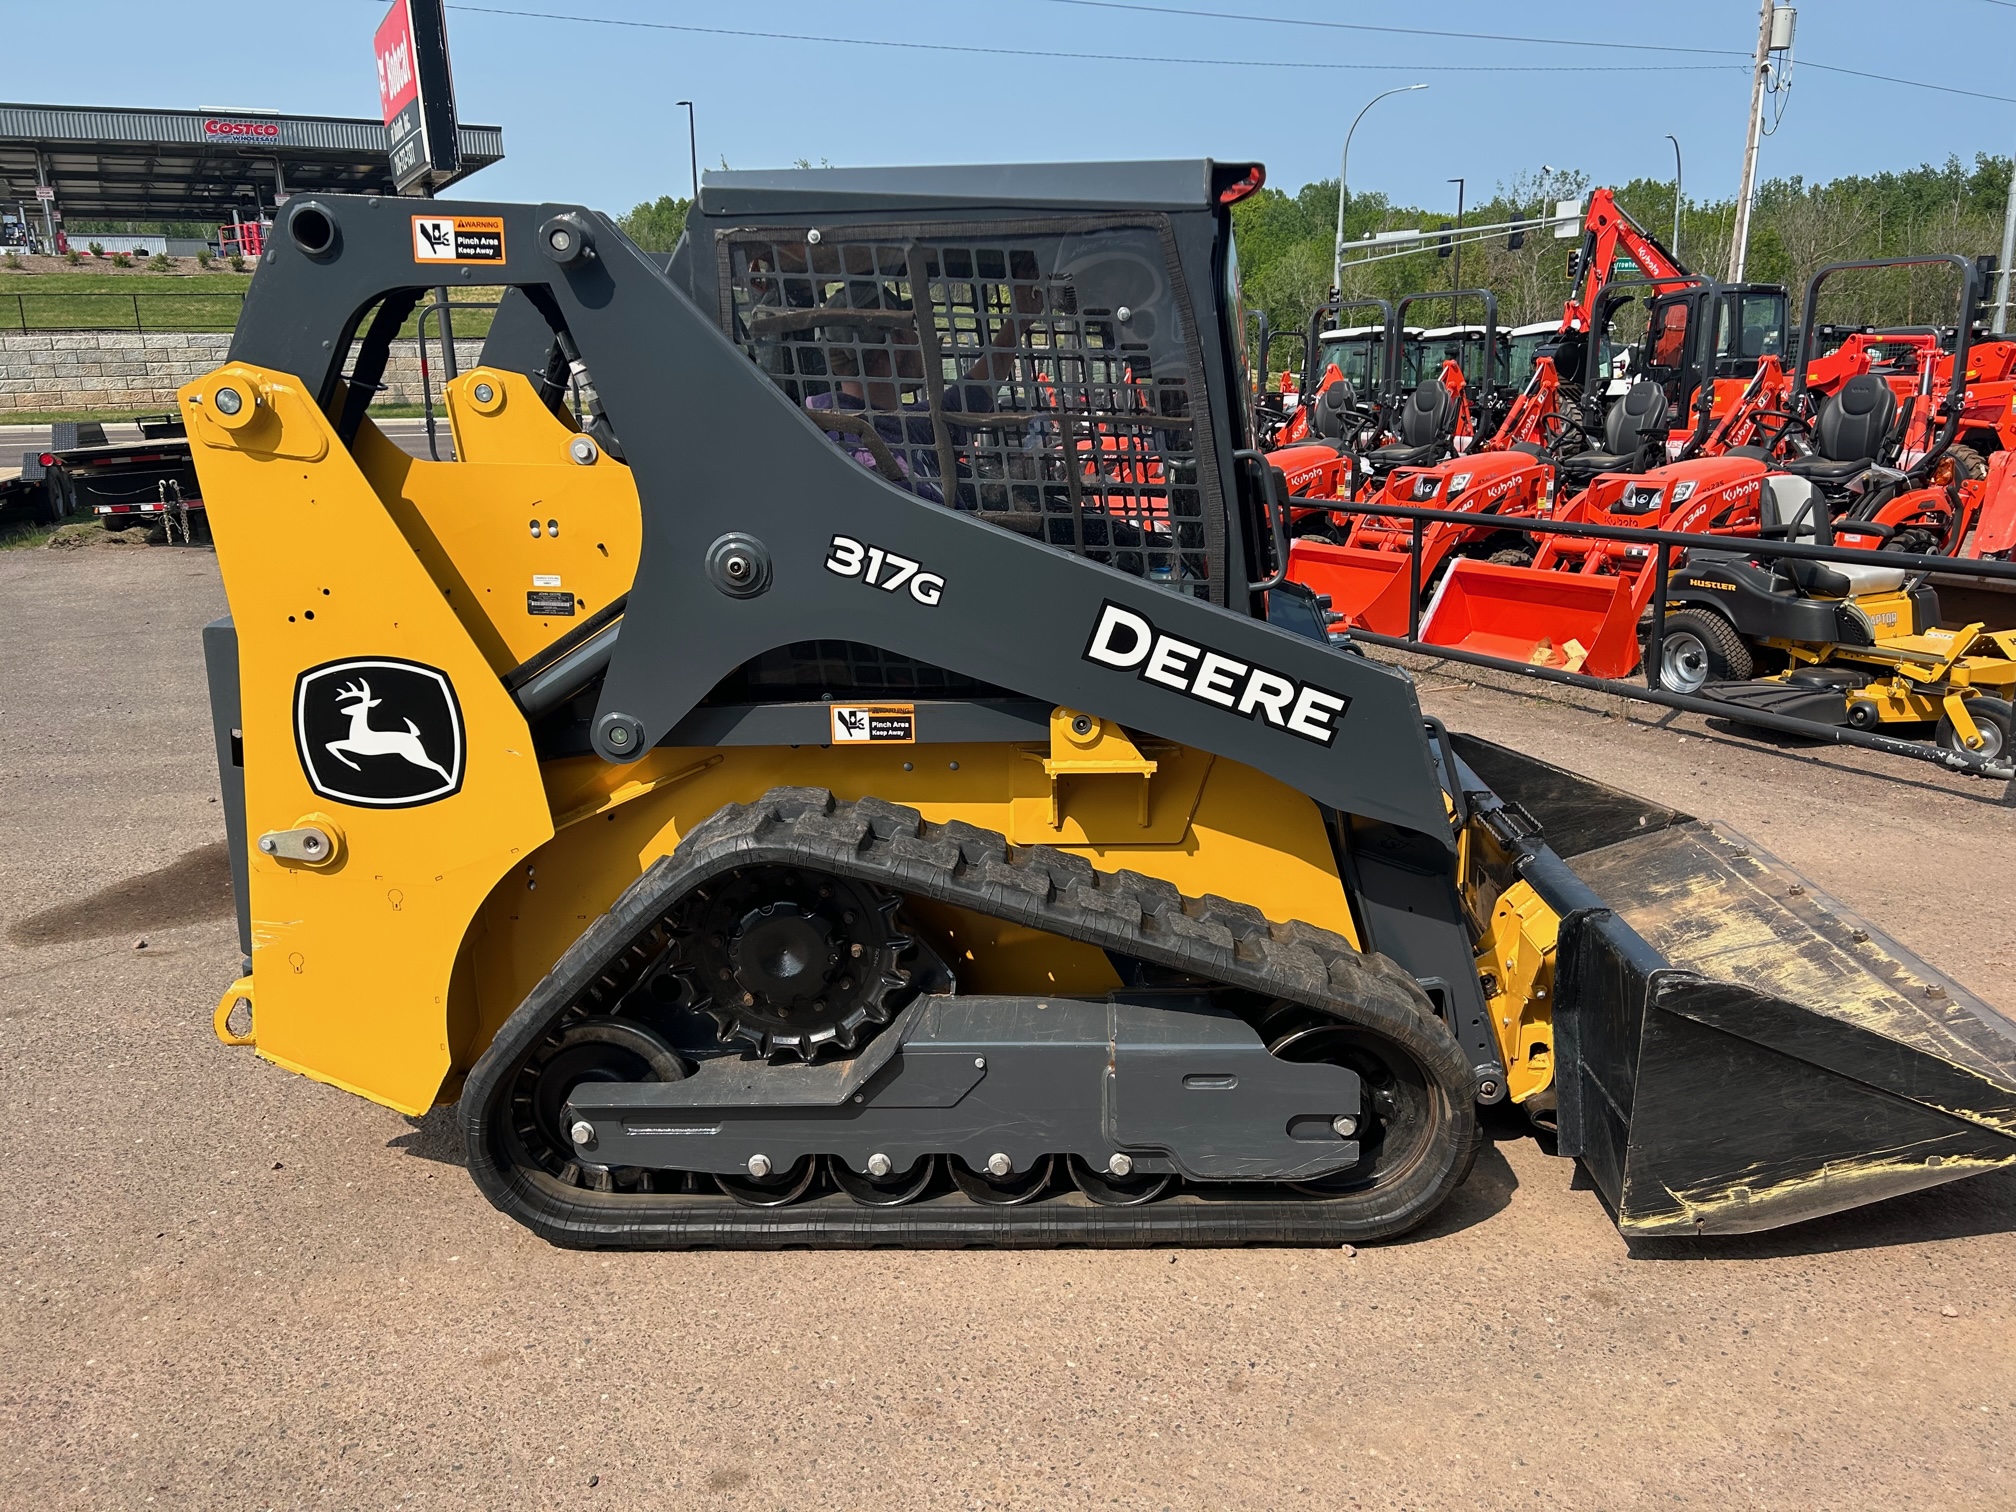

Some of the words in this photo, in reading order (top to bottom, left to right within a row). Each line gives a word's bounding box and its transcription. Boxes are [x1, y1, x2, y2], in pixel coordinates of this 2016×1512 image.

[385, 29, 412, 101] Bobcat
[204, 119, 279, 136] COSTCO
[232, 135, 278, 143] WHOLESALE
[465, 220, 499, 229] WARNING
[457, 236, 479, 245] Pinch
[480, 237, 499, 246] Area
[458, 247, 475, 255] Keep
[1637, 246, 1659, 277] Kubota
[1291, 467, 1323, 486] Kubota
[1487, 475, 1523, 498] Kubota
[1722, 480, 1760, 502] Kubota
[1604, 515, 1639, 527] Kubota
[826, 536, 945, 606] 317G
[1690, 578, 1737, 592] HUSTLER
[1870, 611, 1898, 626] APTOR
[1088, 604, 1346, 742] DEERE
